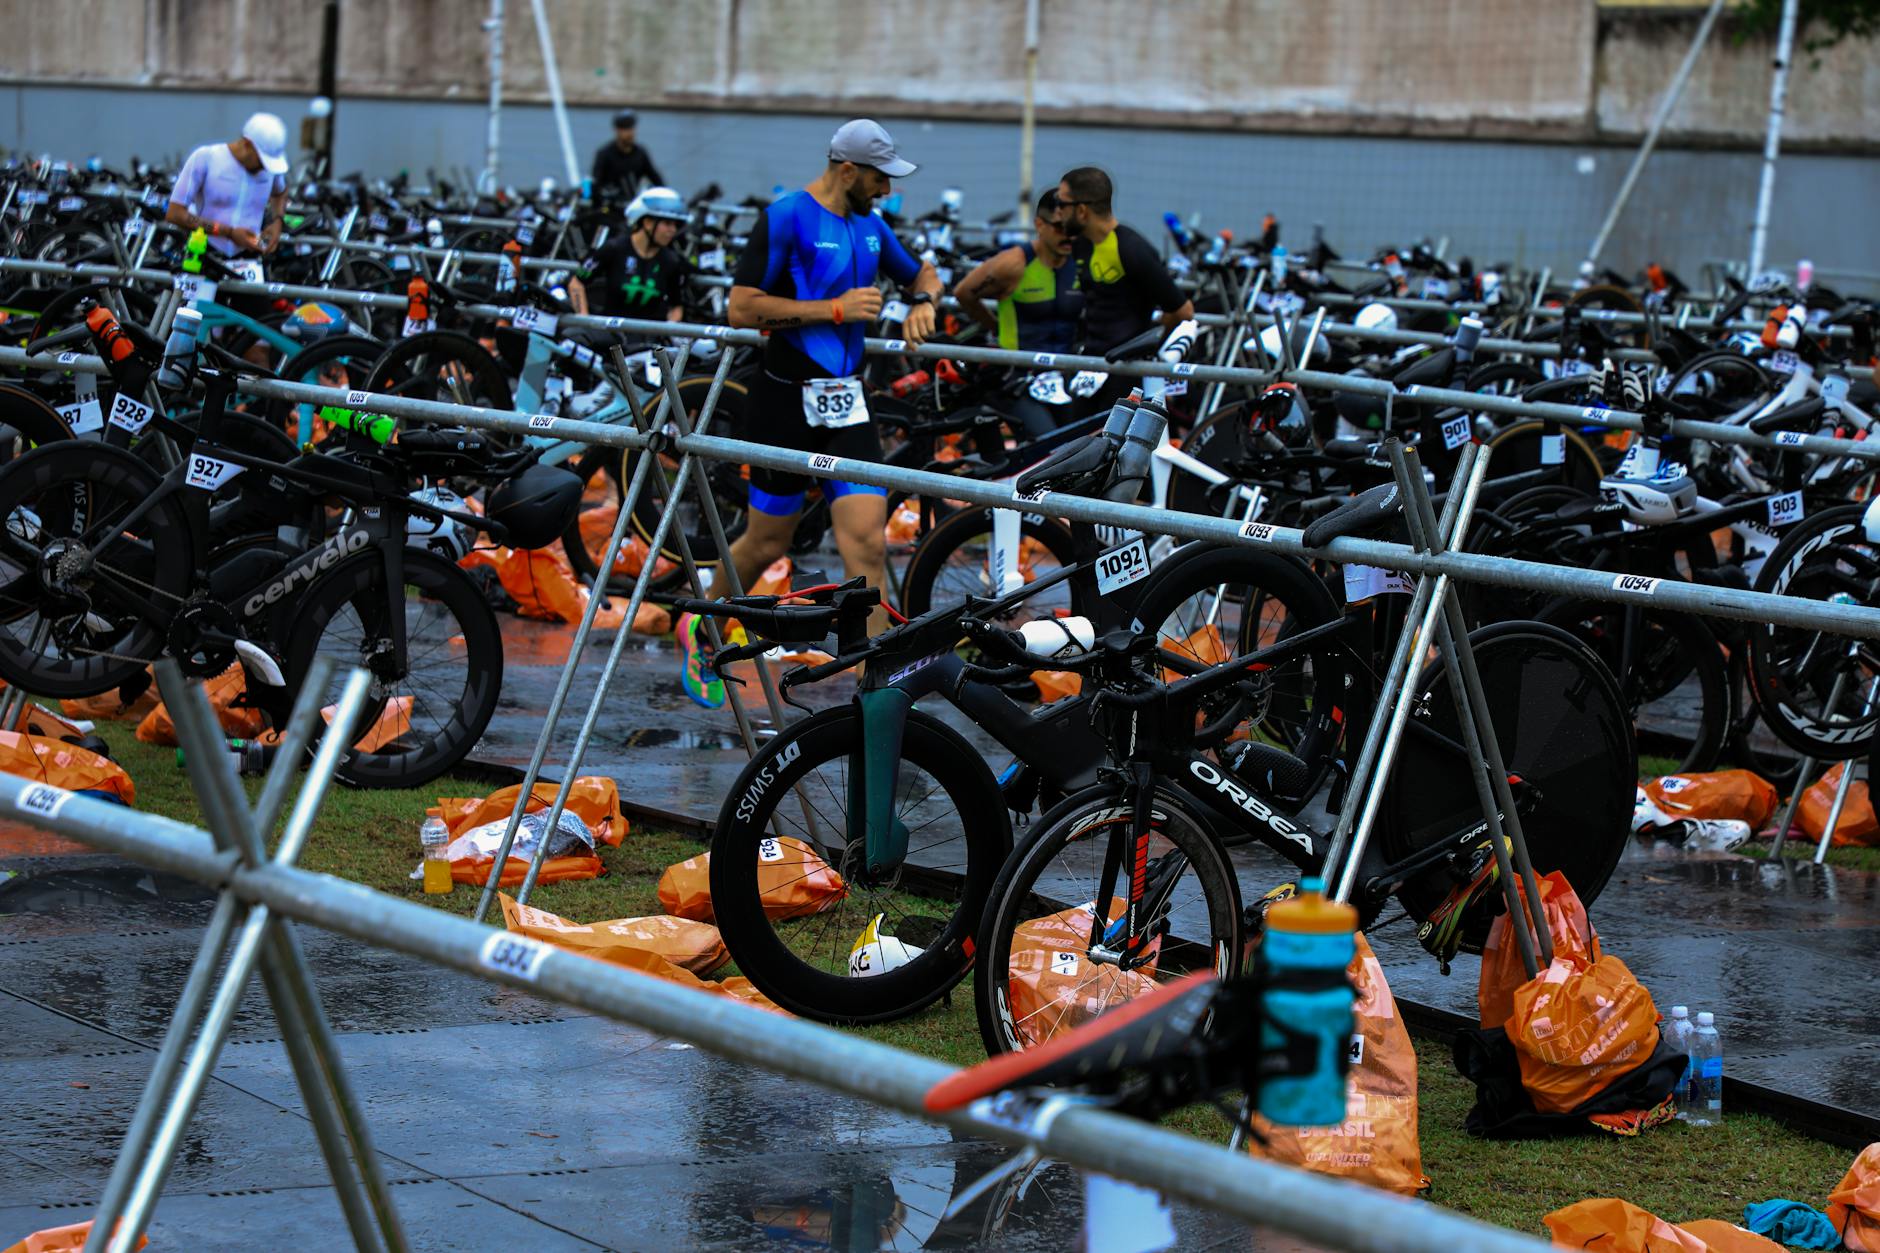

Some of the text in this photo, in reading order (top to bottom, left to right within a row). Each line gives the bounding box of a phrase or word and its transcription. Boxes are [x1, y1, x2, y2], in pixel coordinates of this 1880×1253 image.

[116, 396, 147, 422] 928
[817, 393, 854, 415] 839
[1445, 419, 1467, 439] 901
[194, 457, 224, 476] 927
[814, 456, 834, 469] 1091
[1773, 496, 1797, 516] 903
[1244, 522, 1272, 539] 1093
[1099, 545, 1142, 579] 1092
[1619, 575, 1654, 591] 1094
[736, 740, 802, 824] DT SWISS
[1188, 759, 1313, 856] ORBEA
[1580, 1017, 1629, 1066] BRASIL
